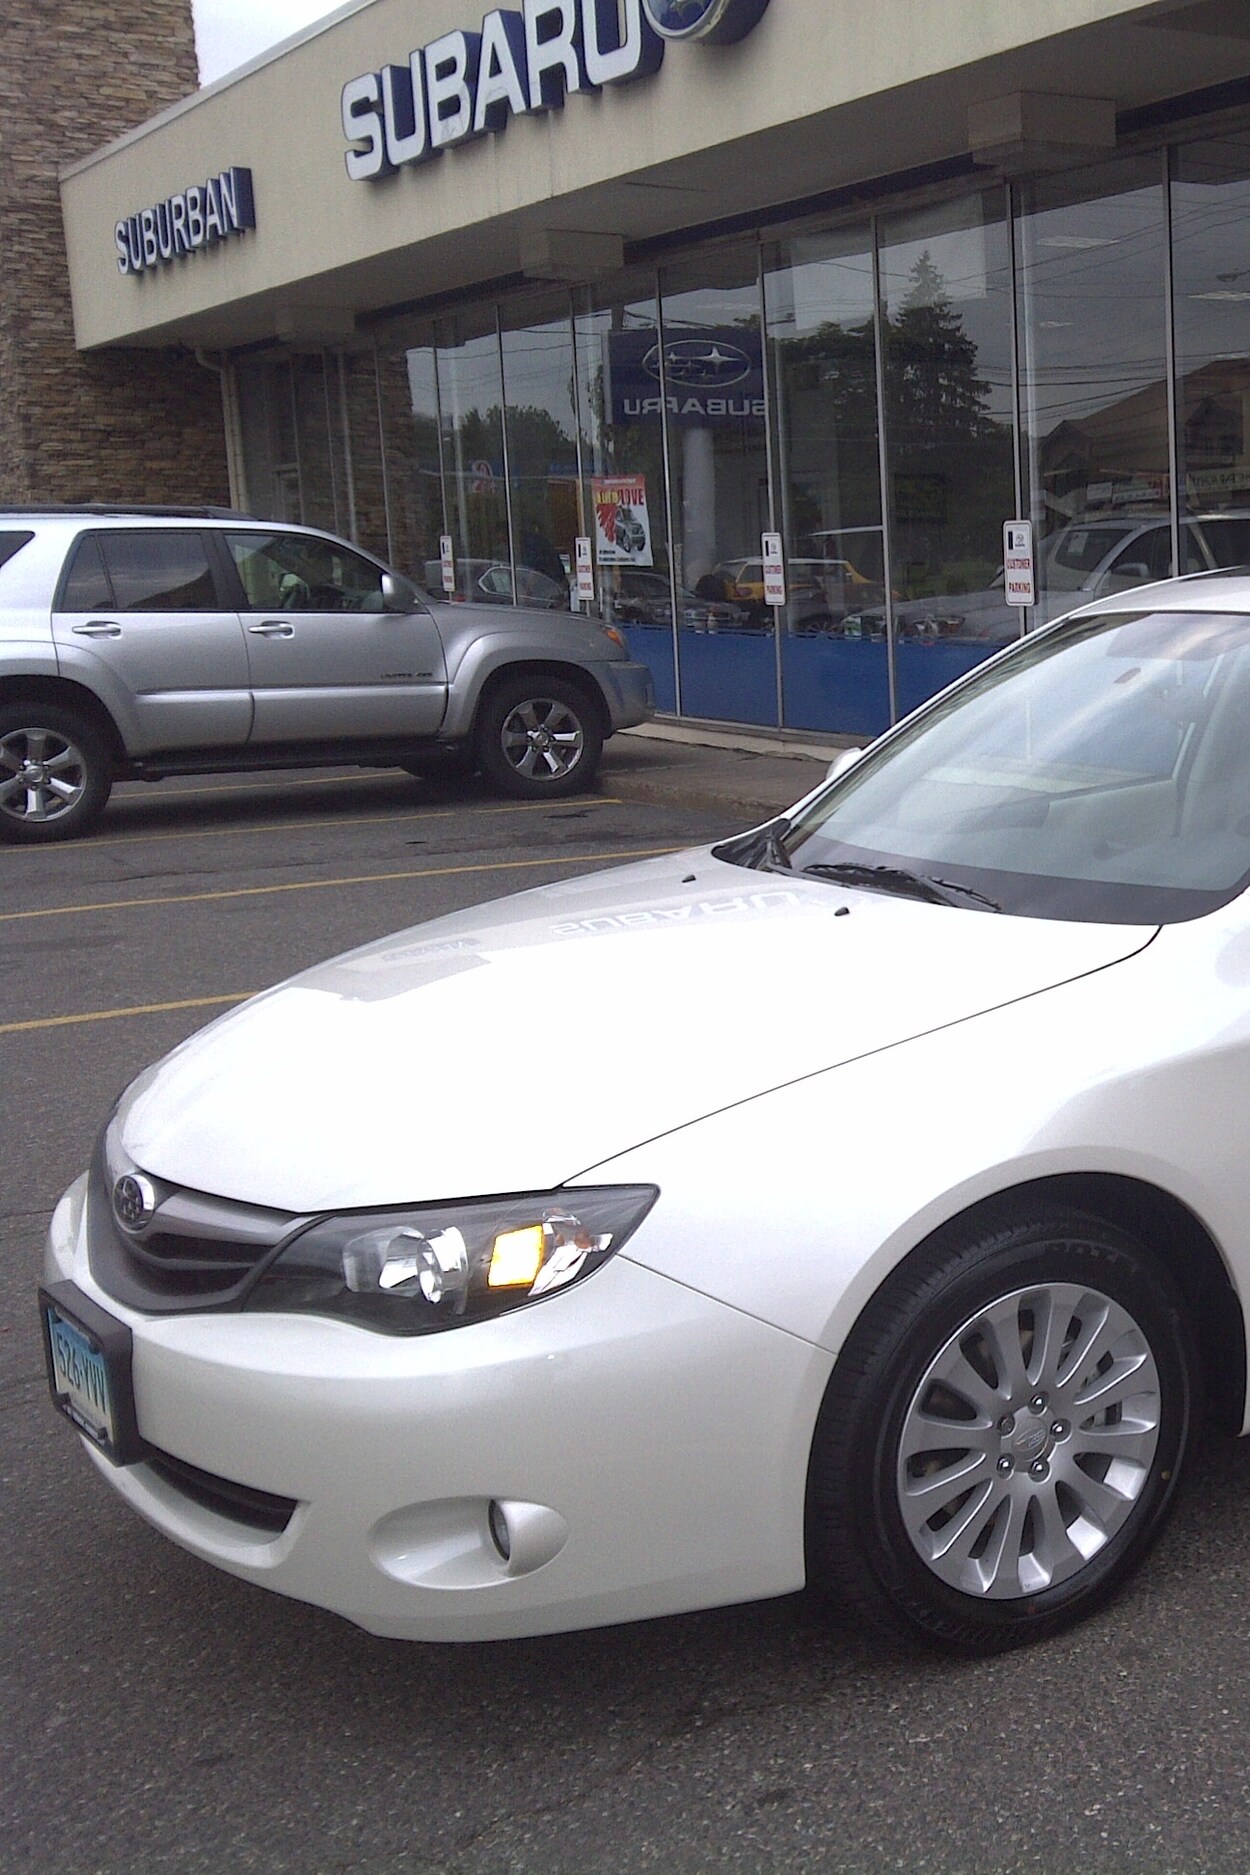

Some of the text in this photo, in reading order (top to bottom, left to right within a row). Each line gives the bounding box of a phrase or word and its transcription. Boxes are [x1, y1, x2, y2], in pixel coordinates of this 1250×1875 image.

[341, 0, 645, 181] SUBARU
[115, 167, 239, 275] SUBURBAN
[1008, 582, 1031, 593] PARKING
